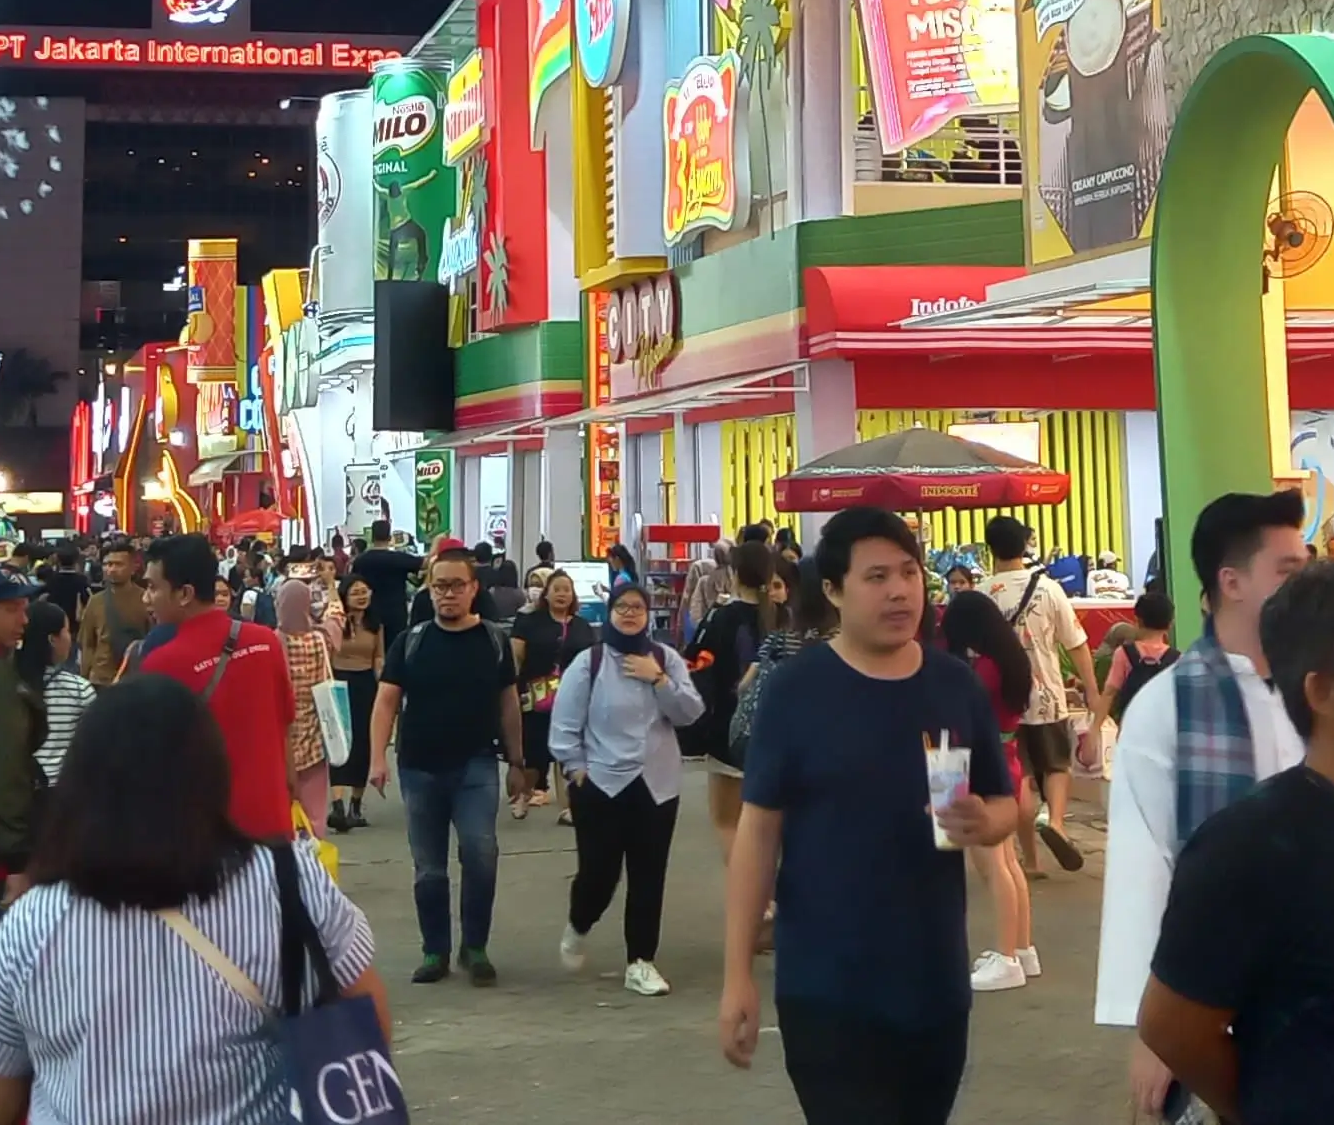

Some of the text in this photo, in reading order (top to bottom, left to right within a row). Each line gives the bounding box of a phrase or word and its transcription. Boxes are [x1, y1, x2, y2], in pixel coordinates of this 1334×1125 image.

[34, 36, 141, 62] Jakarta
[147, 39, 323, 67] International
[608, 288, 670, 350] CITY
